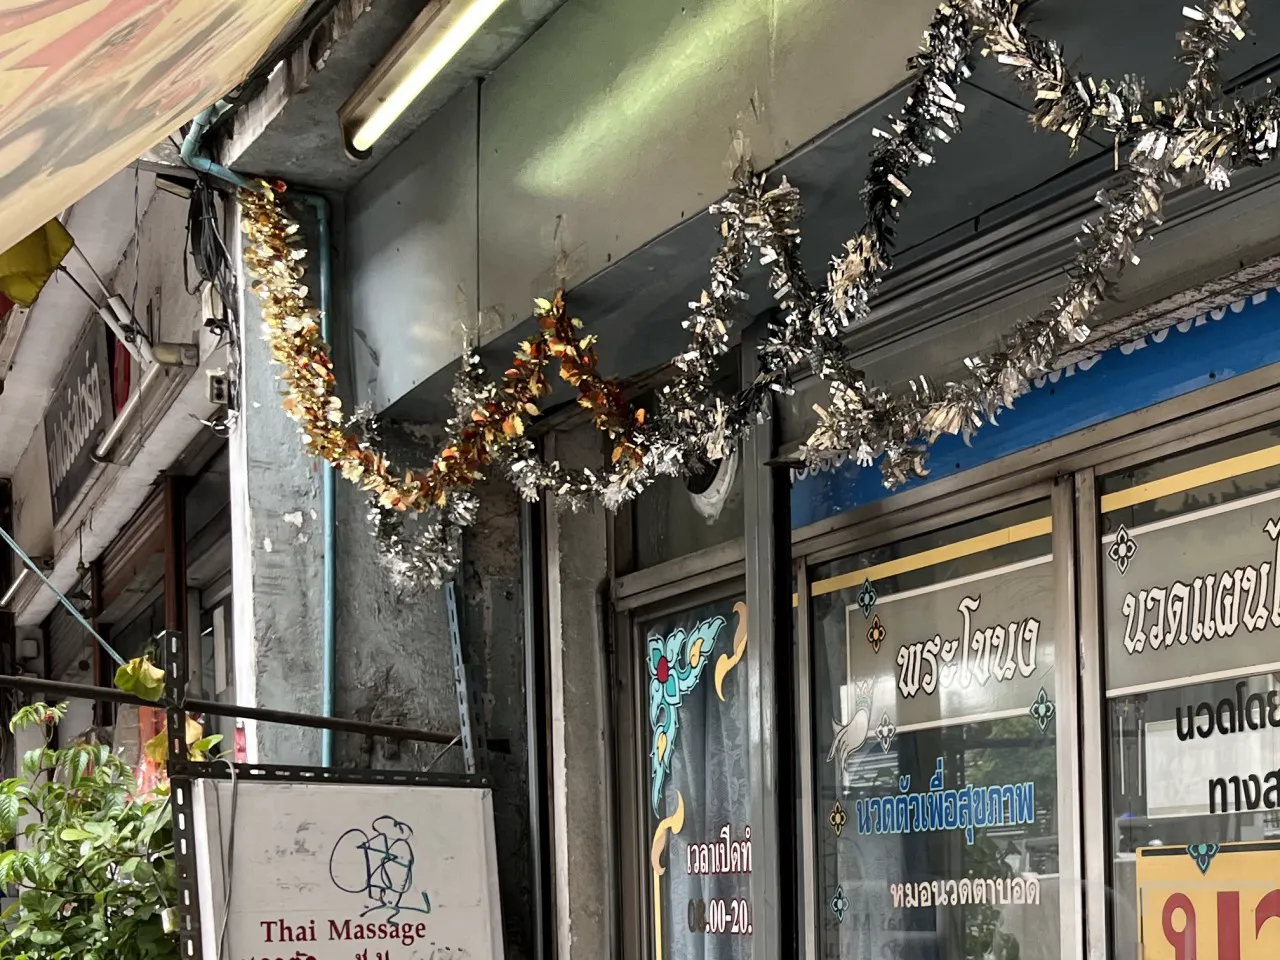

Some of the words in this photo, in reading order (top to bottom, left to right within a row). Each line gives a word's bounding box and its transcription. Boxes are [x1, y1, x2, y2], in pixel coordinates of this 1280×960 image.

[896, 594, 1041, 700] พระโขนง
[856, 756, 1035, 846] นวดตัวเพื่อสุขภาพ
[889, 877, 1041, 909] หมอนวดตาบอด
[260, 918, 317, 942] Thai
[327, 918, 427, 947] Massage
